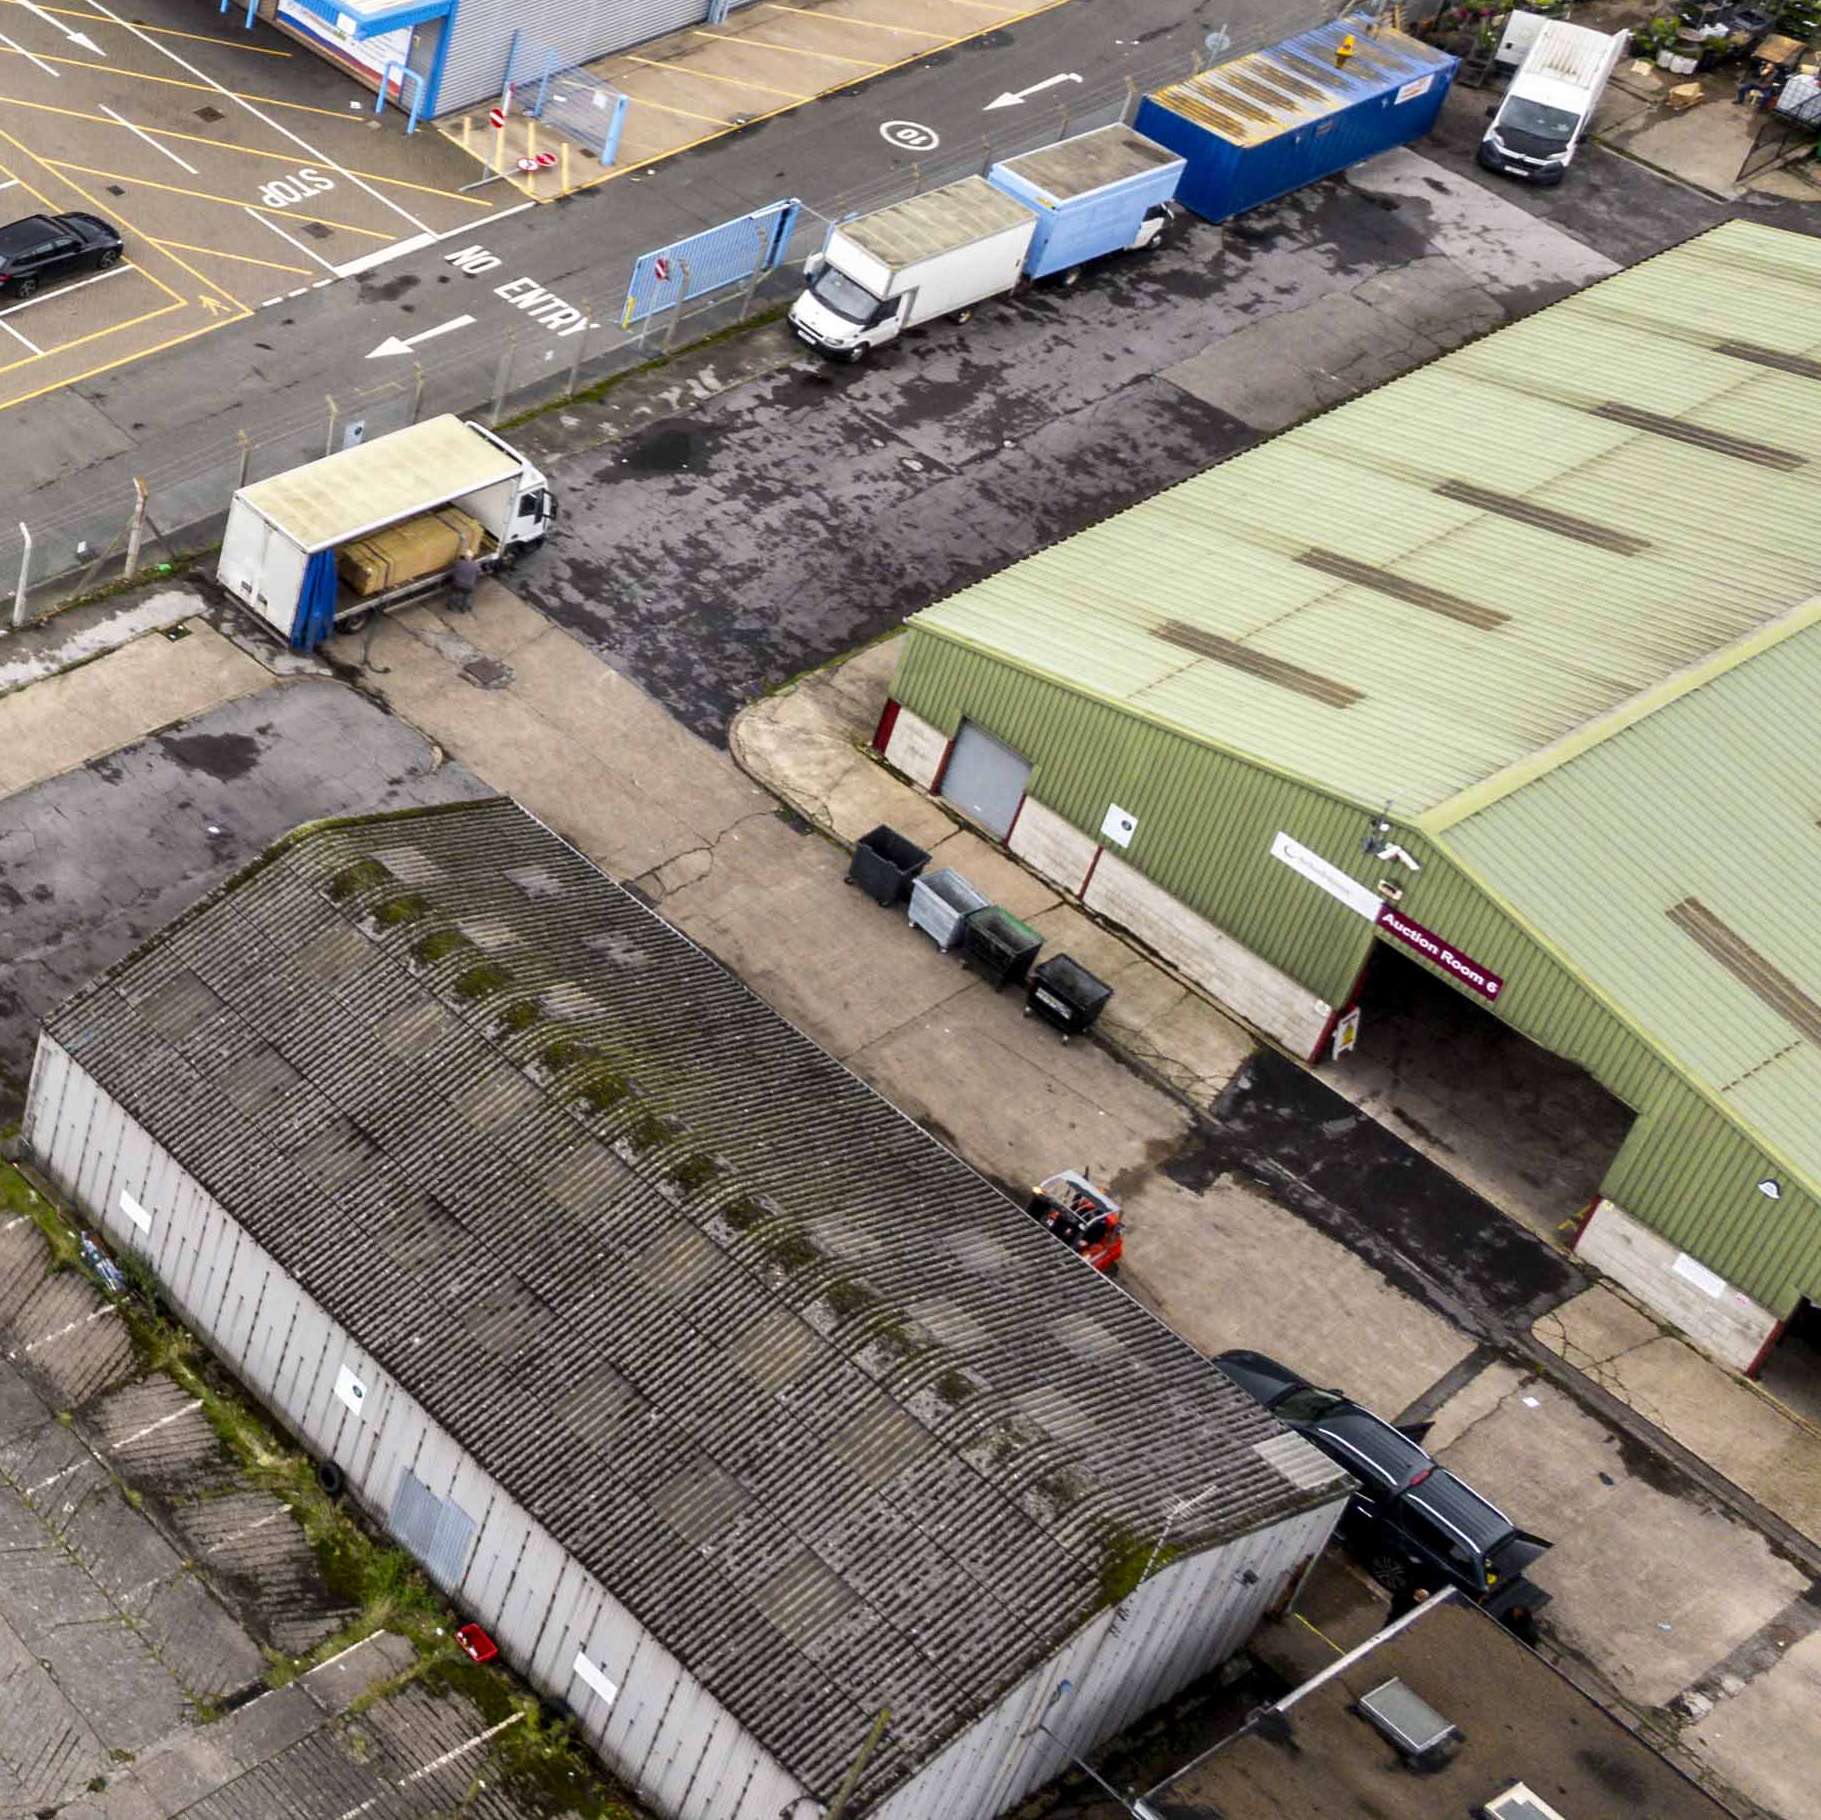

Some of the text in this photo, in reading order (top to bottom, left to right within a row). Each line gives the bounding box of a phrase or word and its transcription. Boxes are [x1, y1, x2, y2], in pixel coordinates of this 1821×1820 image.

[257, 168, 335, 208] STOP
[444, 244, 602, 338] NO ENTRY
[1380, 911, 1498, 995] Auction Room 6
